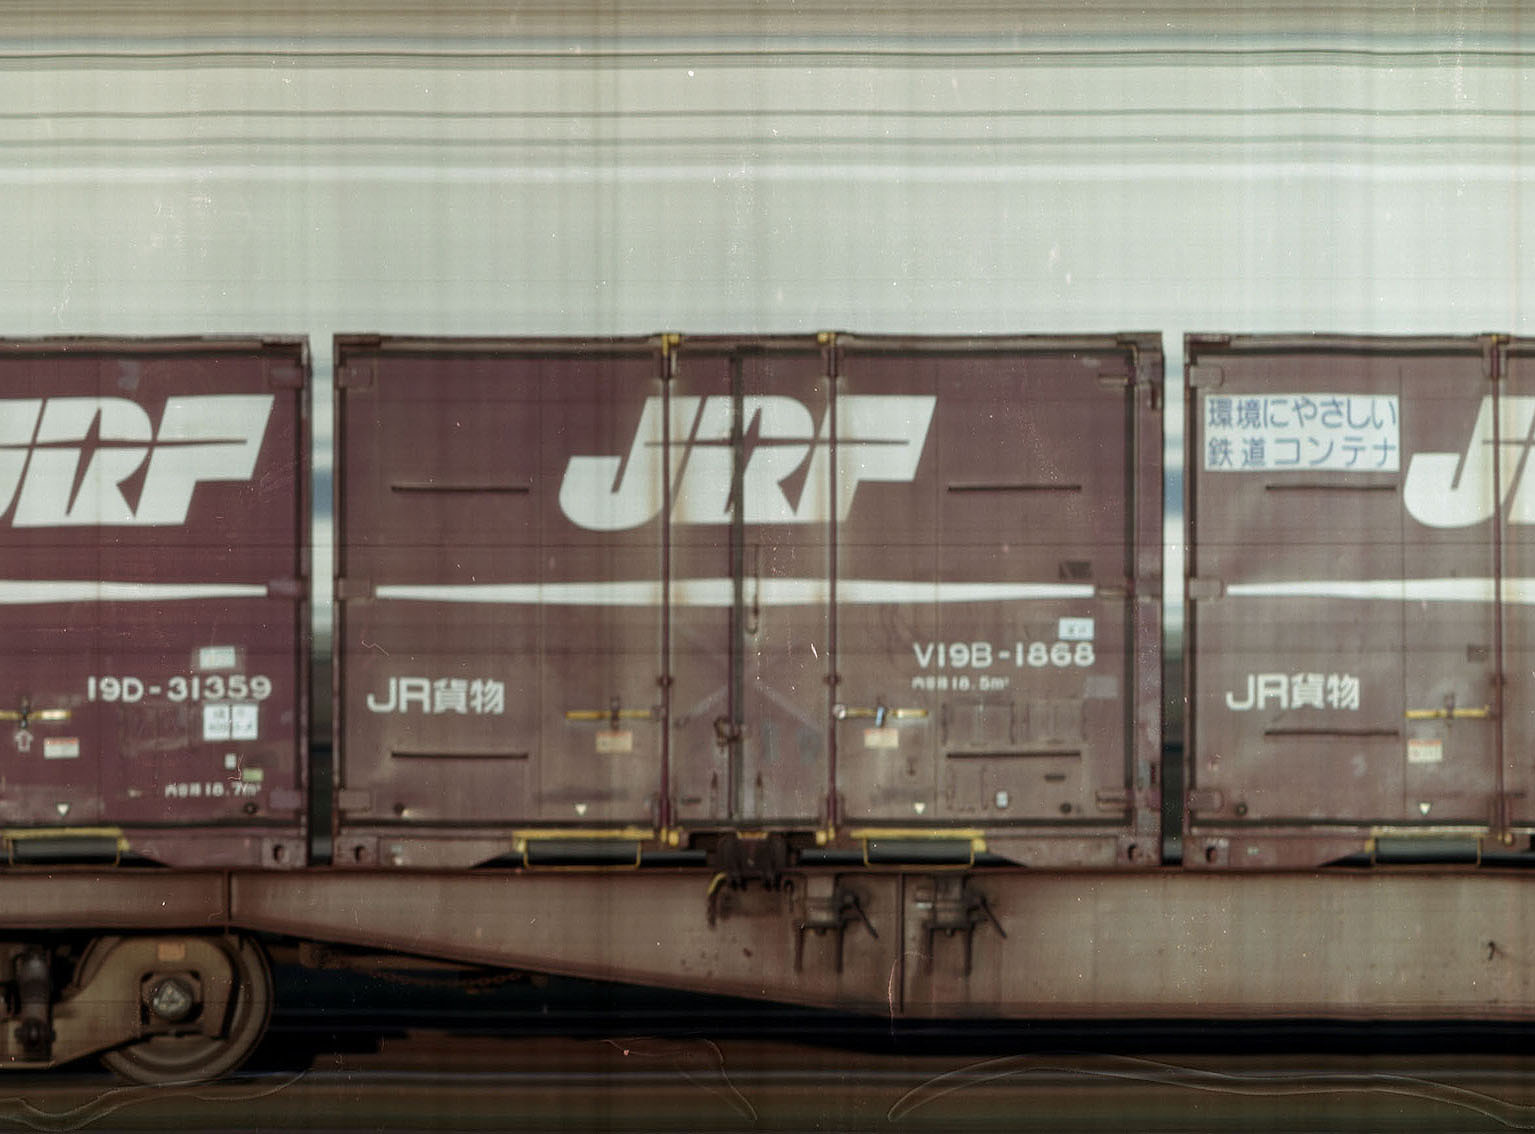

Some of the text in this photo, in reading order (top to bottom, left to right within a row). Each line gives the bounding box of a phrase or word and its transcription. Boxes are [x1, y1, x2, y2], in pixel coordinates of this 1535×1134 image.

[1208, 397, 1397, 430] 環境にやさしい
[559, 395, 937, 531] JRF
[1208, 437, 1396, 468] 鉄道コンテナ
[913, 641, 1095, 669] V19B-1868
[87, 675, 272, 702] 19D-31359
[367, 677, 505, 714] JR貨物
[1225, 673, 1360, 710] JR貨物
